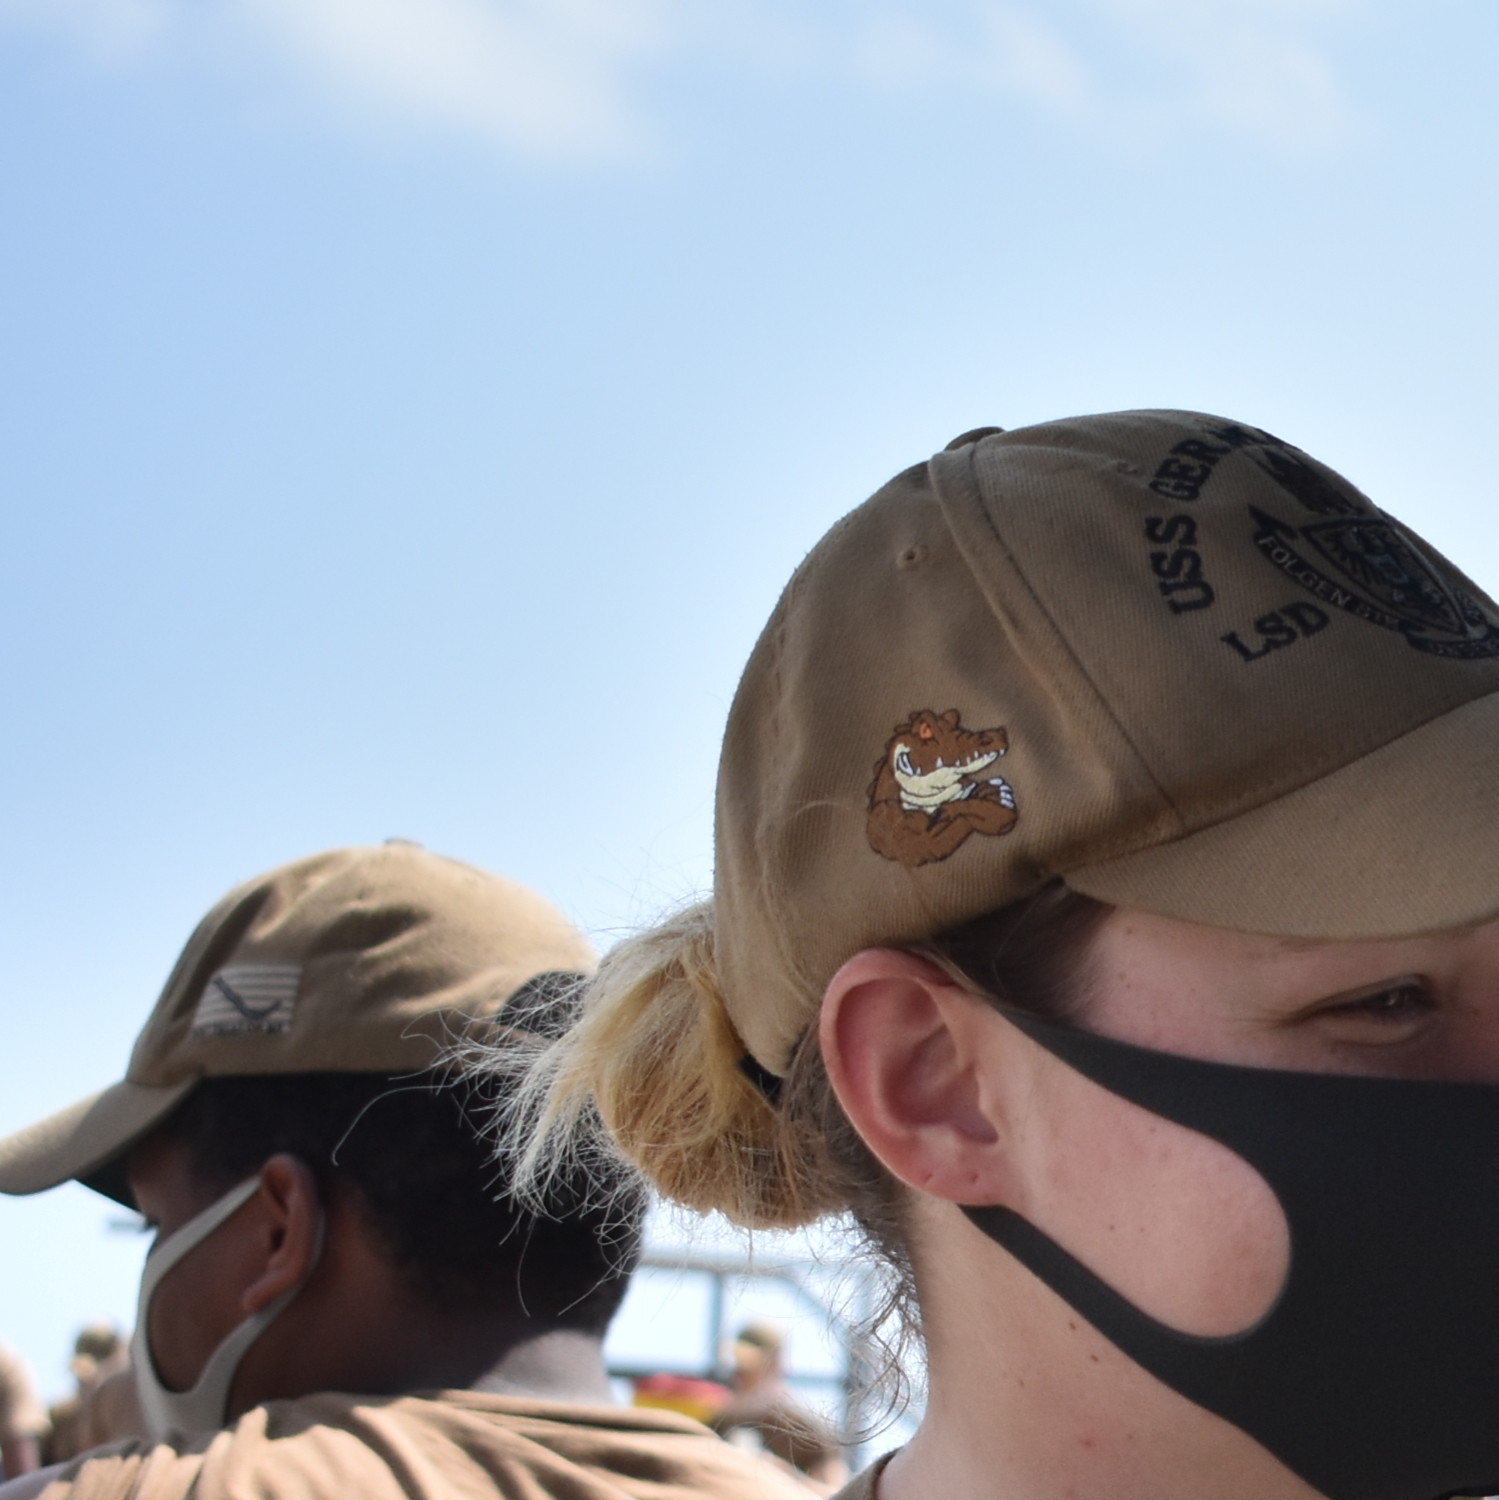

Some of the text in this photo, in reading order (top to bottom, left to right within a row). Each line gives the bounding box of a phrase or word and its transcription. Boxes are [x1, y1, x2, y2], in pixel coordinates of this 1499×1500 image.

[1145, 513, 1216, 614] USS
[1258, 536, 1351, 607] FOLGEN
[1221, 602, 1330, 661] LSD
